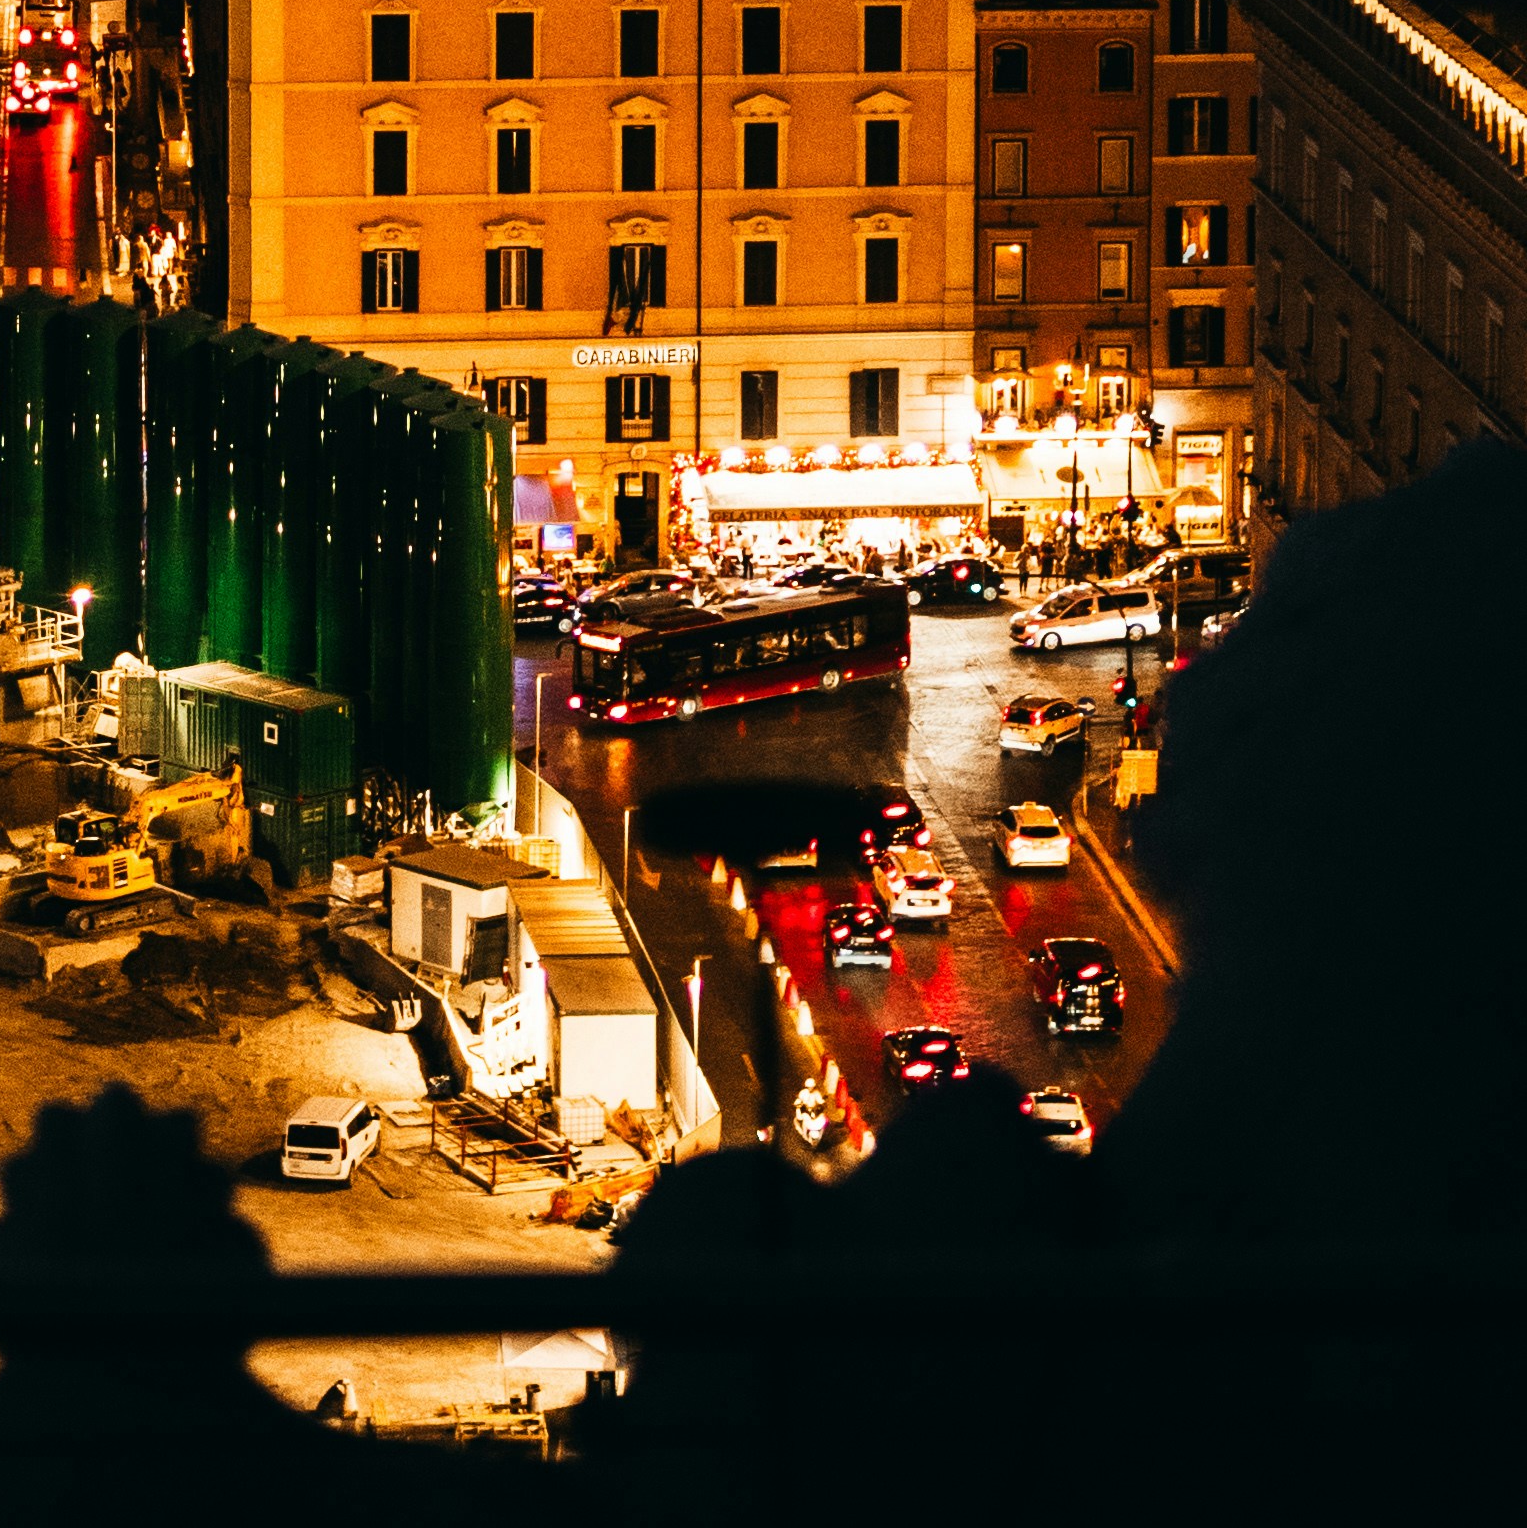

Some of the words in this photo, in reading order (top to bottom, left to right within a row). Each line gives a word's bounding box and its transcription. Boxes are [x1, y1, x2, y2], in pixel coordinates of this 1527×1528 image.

[576, 347, 696, 365] CARABINIERI
[711, 509, 788, 522] GELATERIA
[800, 508, 847, 519] SNACK
[851, 507, 878, 518] BAR
[892, 505, 979, 518] RISTORANTE
[1180, 522, 1219, 530] TIGER
